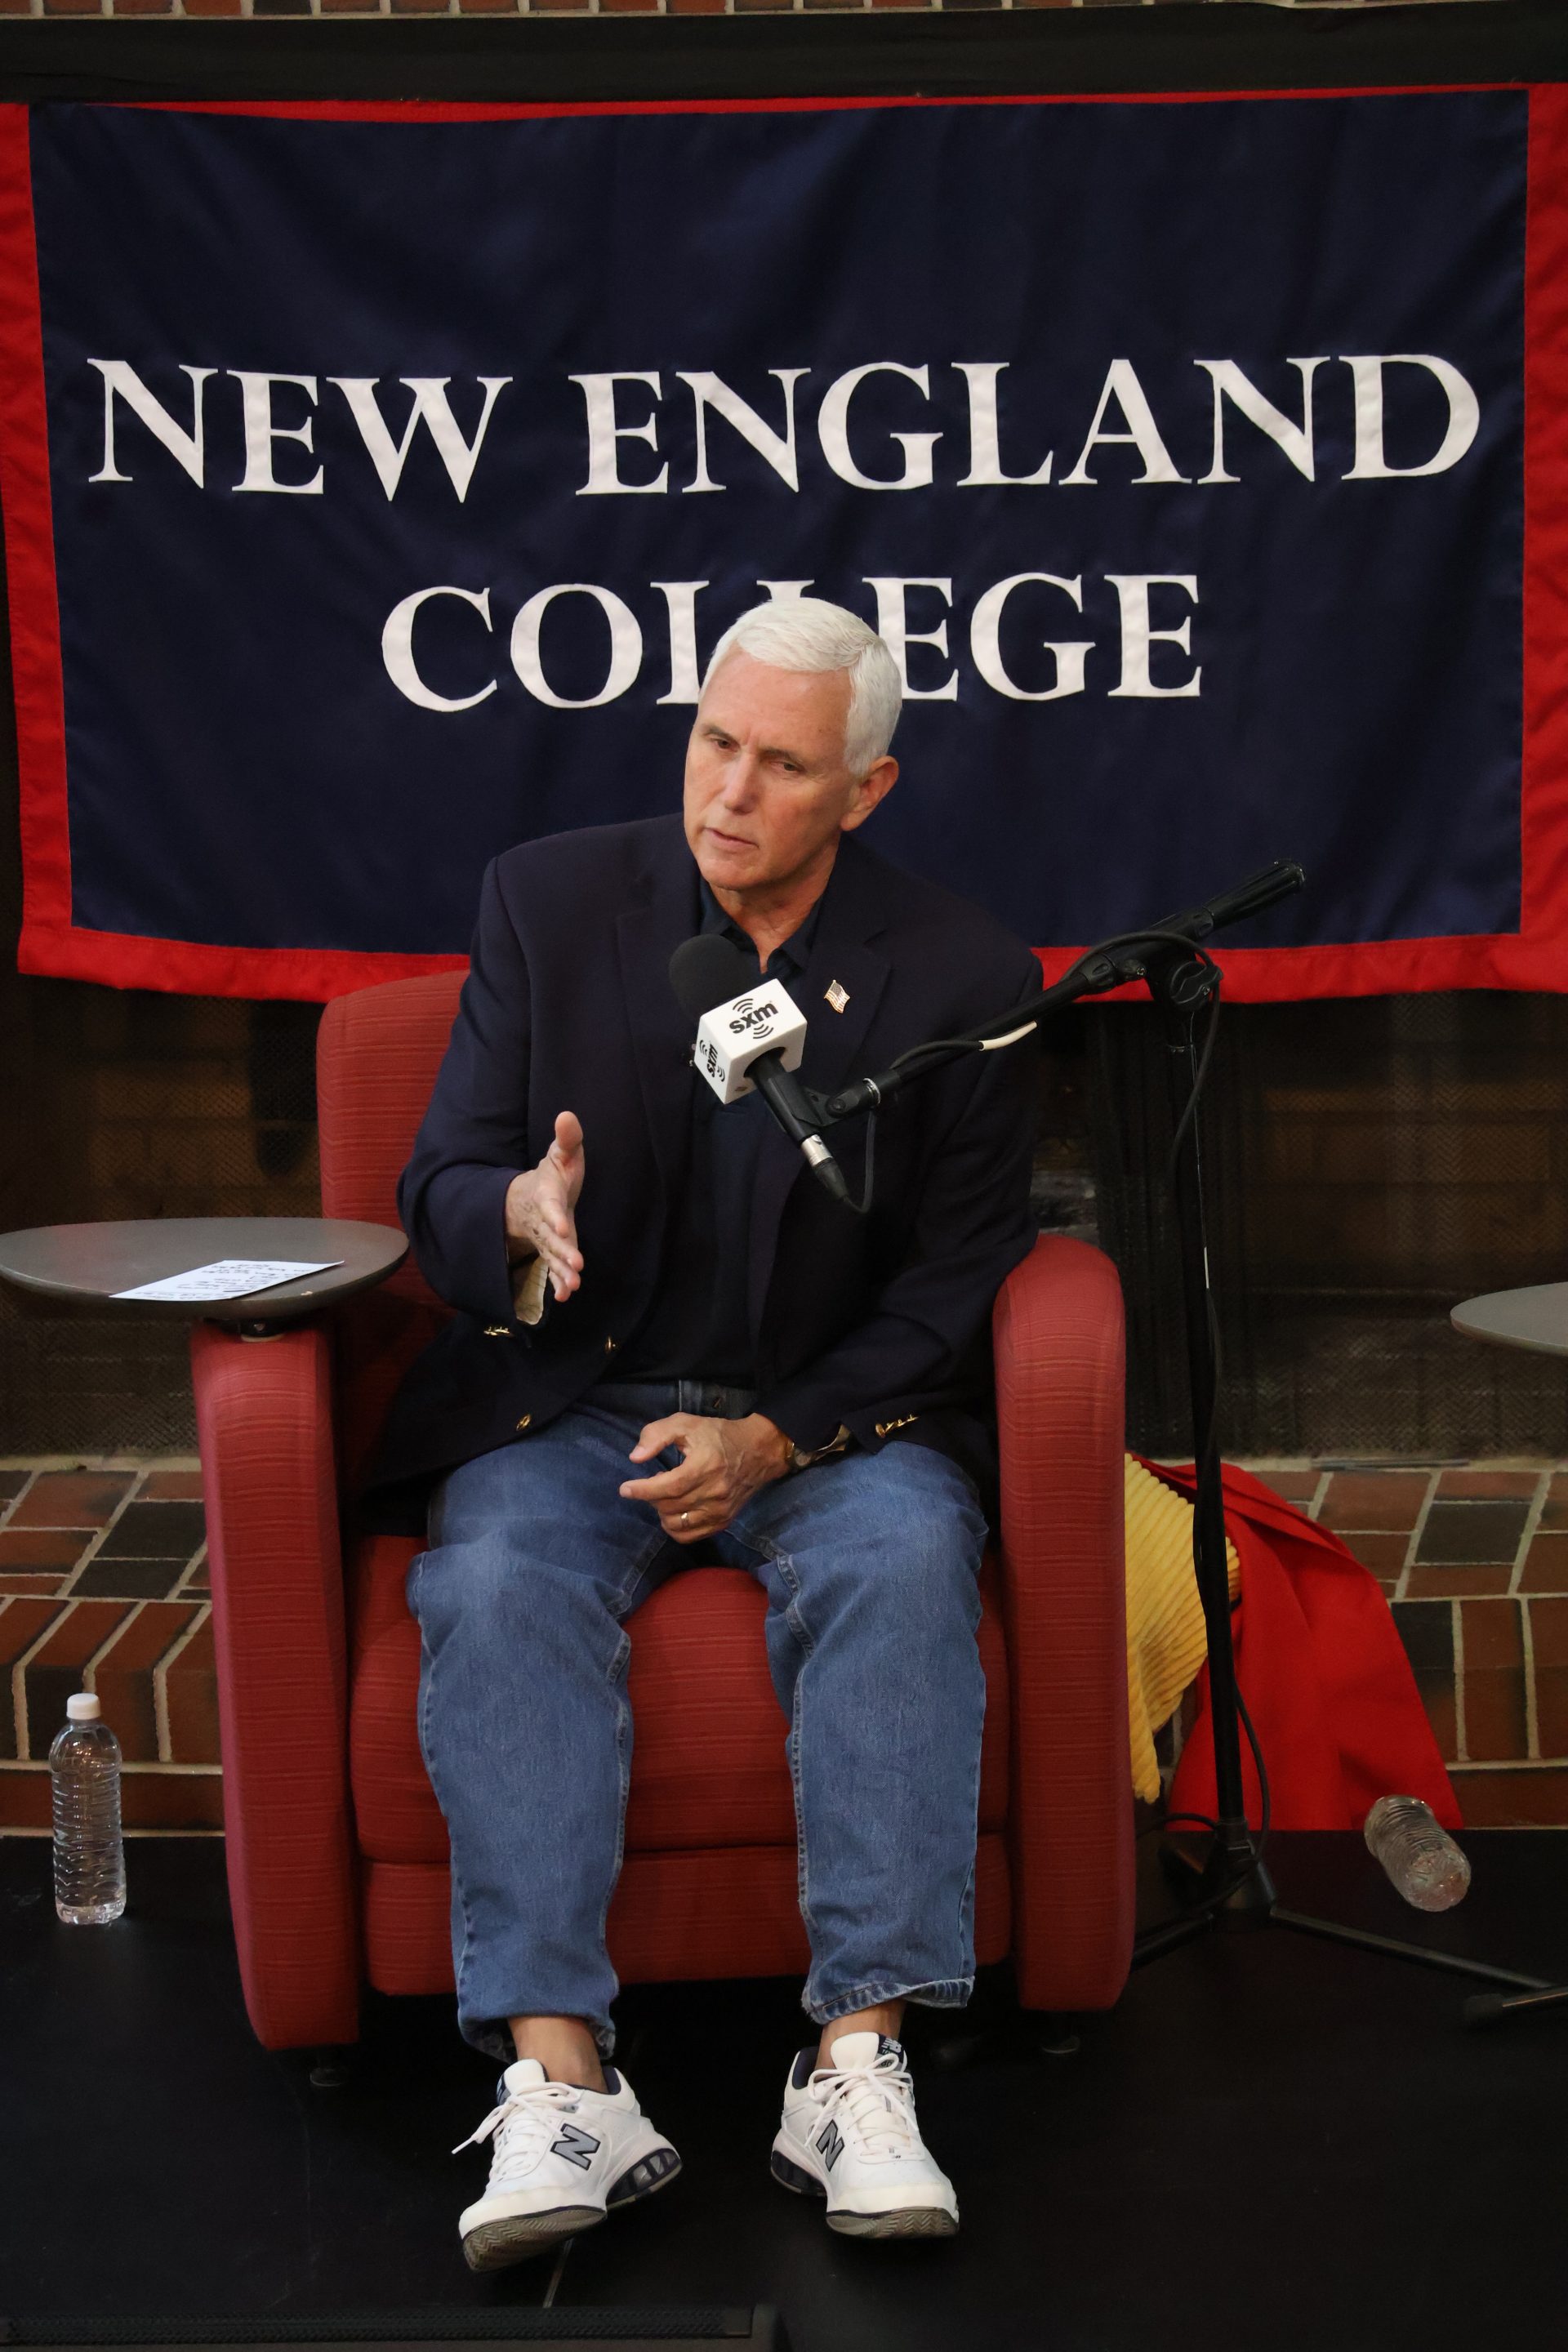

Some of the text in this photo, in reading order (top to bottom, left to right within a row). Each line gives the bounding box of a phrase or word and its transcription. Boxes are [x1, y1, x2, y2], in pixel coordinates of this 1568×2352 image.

[87, 354, 1480, 503] NEW ENGLAND
[381, 572, 1204, 712] COLEGE
[729, 1003, 778, 1035] sxm
[706, 1043, 719, 1078] sxm
[550, 2123, 601, 2171] N
[815, 2119, 846, 2172] N
